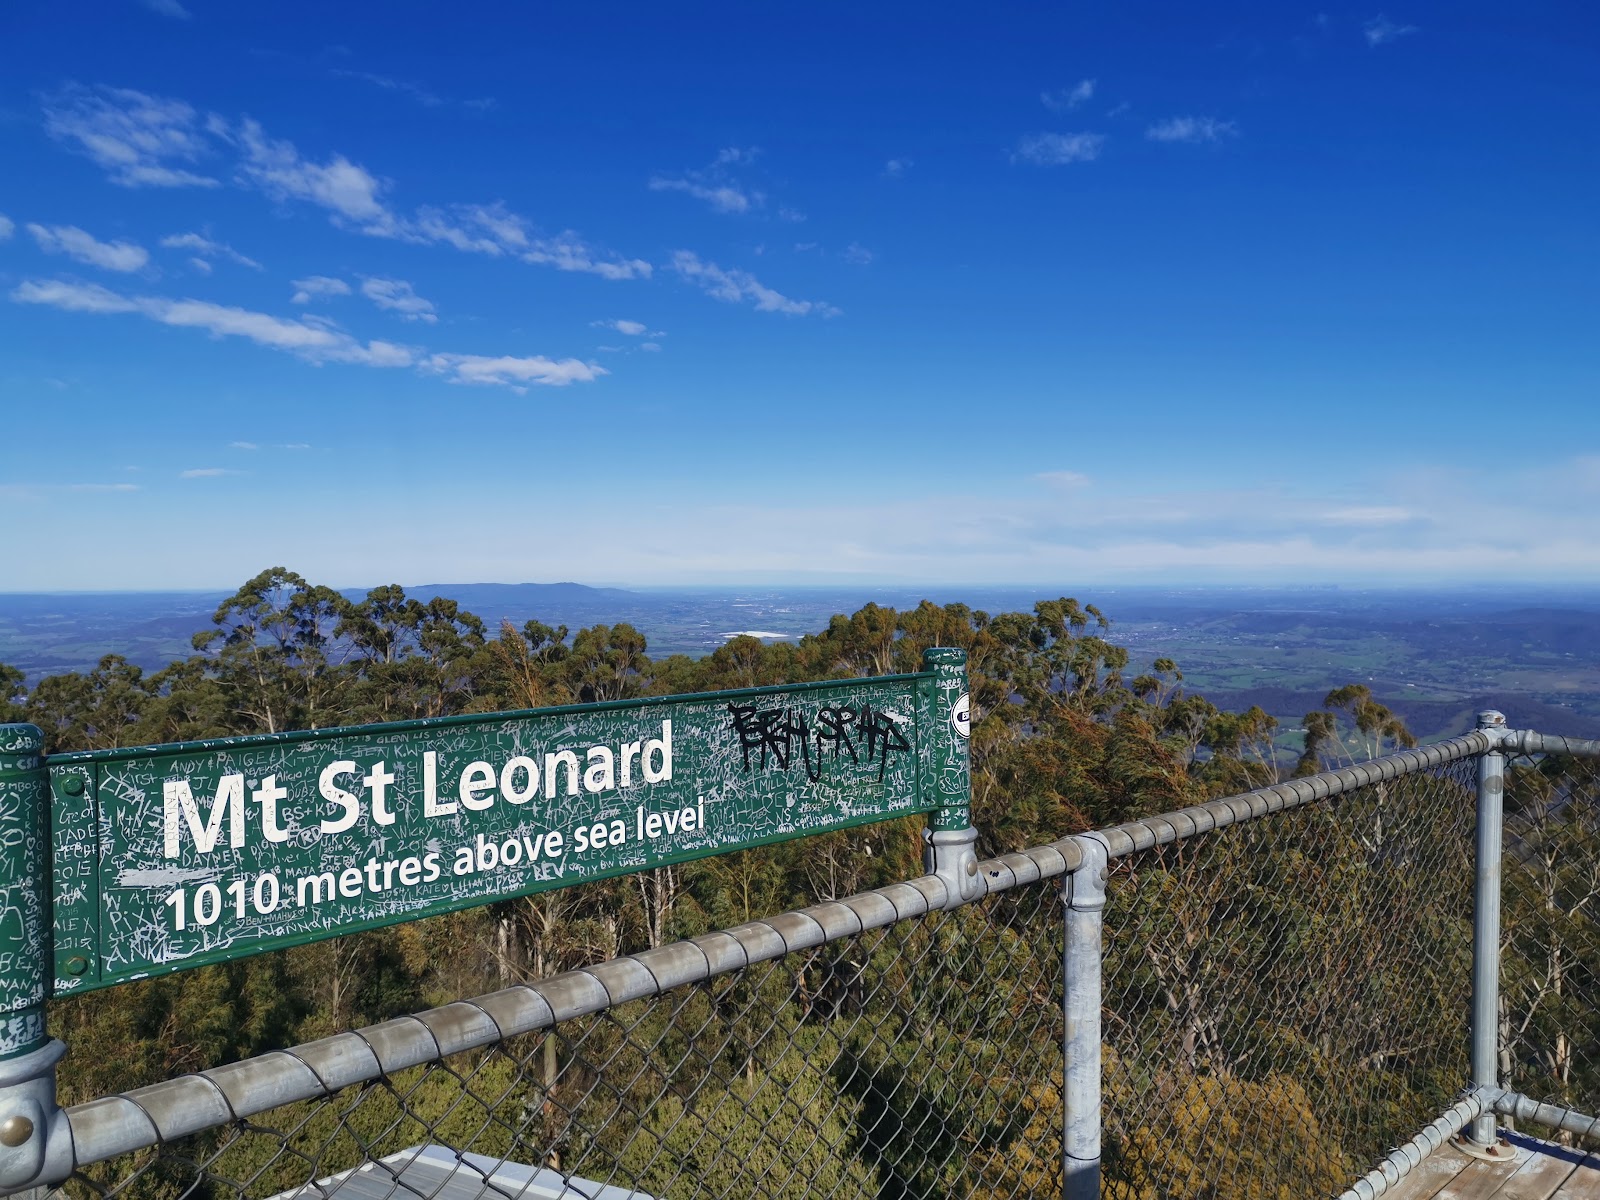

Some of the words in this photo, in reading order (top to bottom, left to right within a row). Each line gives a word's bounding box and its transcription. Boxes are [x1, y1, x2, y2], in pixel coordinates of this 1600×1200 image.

[163, 772, 289, 860] Mt
[318, 760, 396, 835] St
[423, 719, 673, 818] Leonard
[165, 873, 281, 931] 1010
[297, 846, 442, 907] metres
[453, 831, 564, 882] above
[573, 819, 627, 853] sea
[637, 795, 704, 843] level
